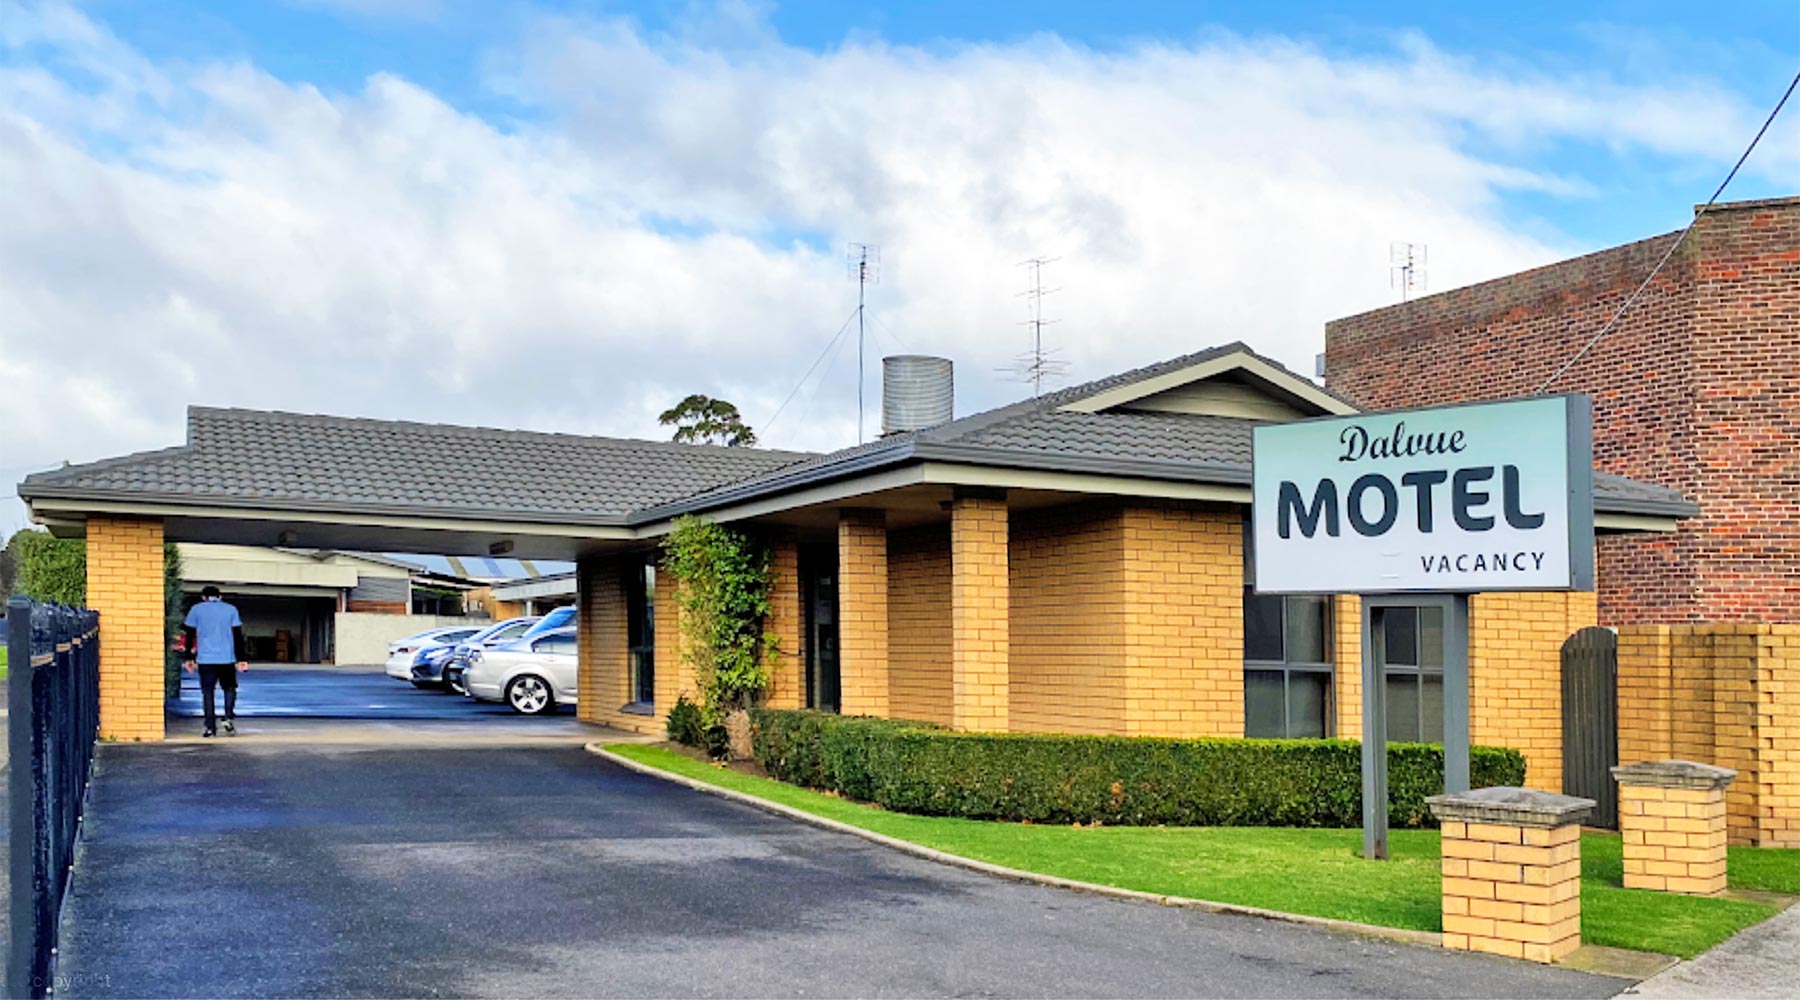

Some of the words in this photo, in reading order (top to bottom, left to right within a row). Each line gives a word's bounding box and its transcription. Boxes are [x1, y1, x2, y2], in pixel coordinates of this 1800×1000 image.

[1339, 421, 1466, 462] Dalvue
[1278, 464, 1545, 539] MOTEL
[1421, 552, 1545, 573] VACANCY
